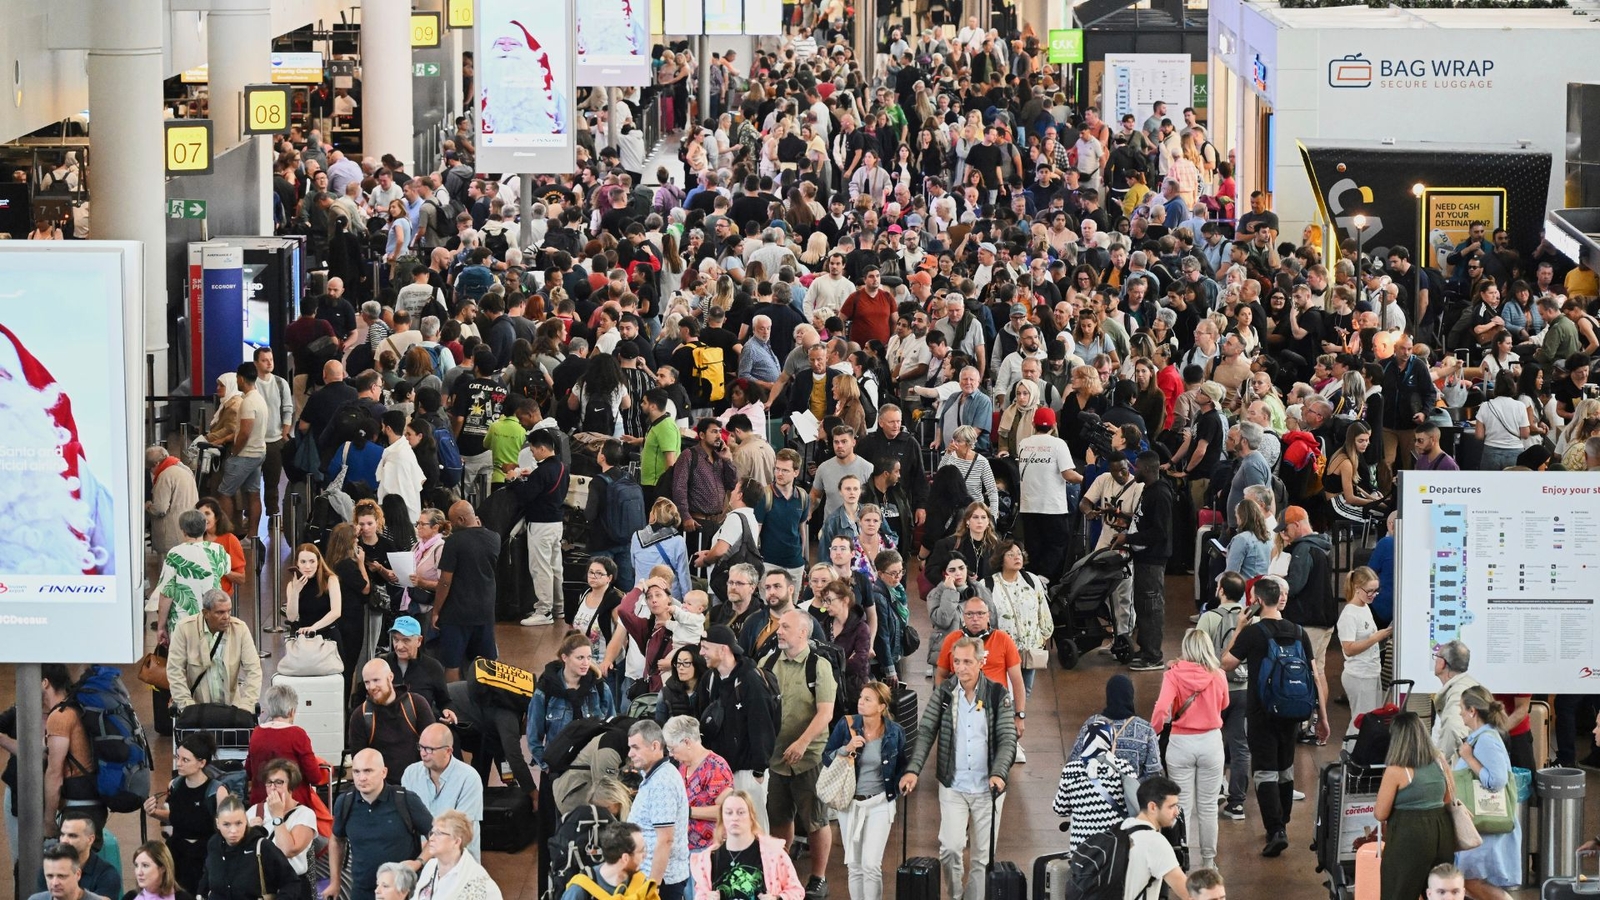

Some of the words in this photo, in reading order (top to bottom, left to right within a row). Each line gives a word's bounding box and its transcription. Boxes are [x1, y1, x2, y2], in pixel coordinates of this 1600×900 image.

[414, 26, 434, 41] 09
[1380, 60, 1425, 77] BAG
[1431, 60, 1494, 77] WRAP
[1380, 80, 1428, 88] SECURE
[1434, 80, 1493, 89] LUGGAGE
[255, 104, 281, 124] 08
[173, 143, 202, 164] 07
[1435, 211, 1445, 219] AT
[1447, 211, 1469, 219] YOUR
[1429, 485, 1482, 495] Departures
[1542, 485, 1568, 496] Enjoy
[1569, 487, 1591, 496] your
[39, 585, 106, 593] FINNAIR
[497, 671, 516, 683] THE
